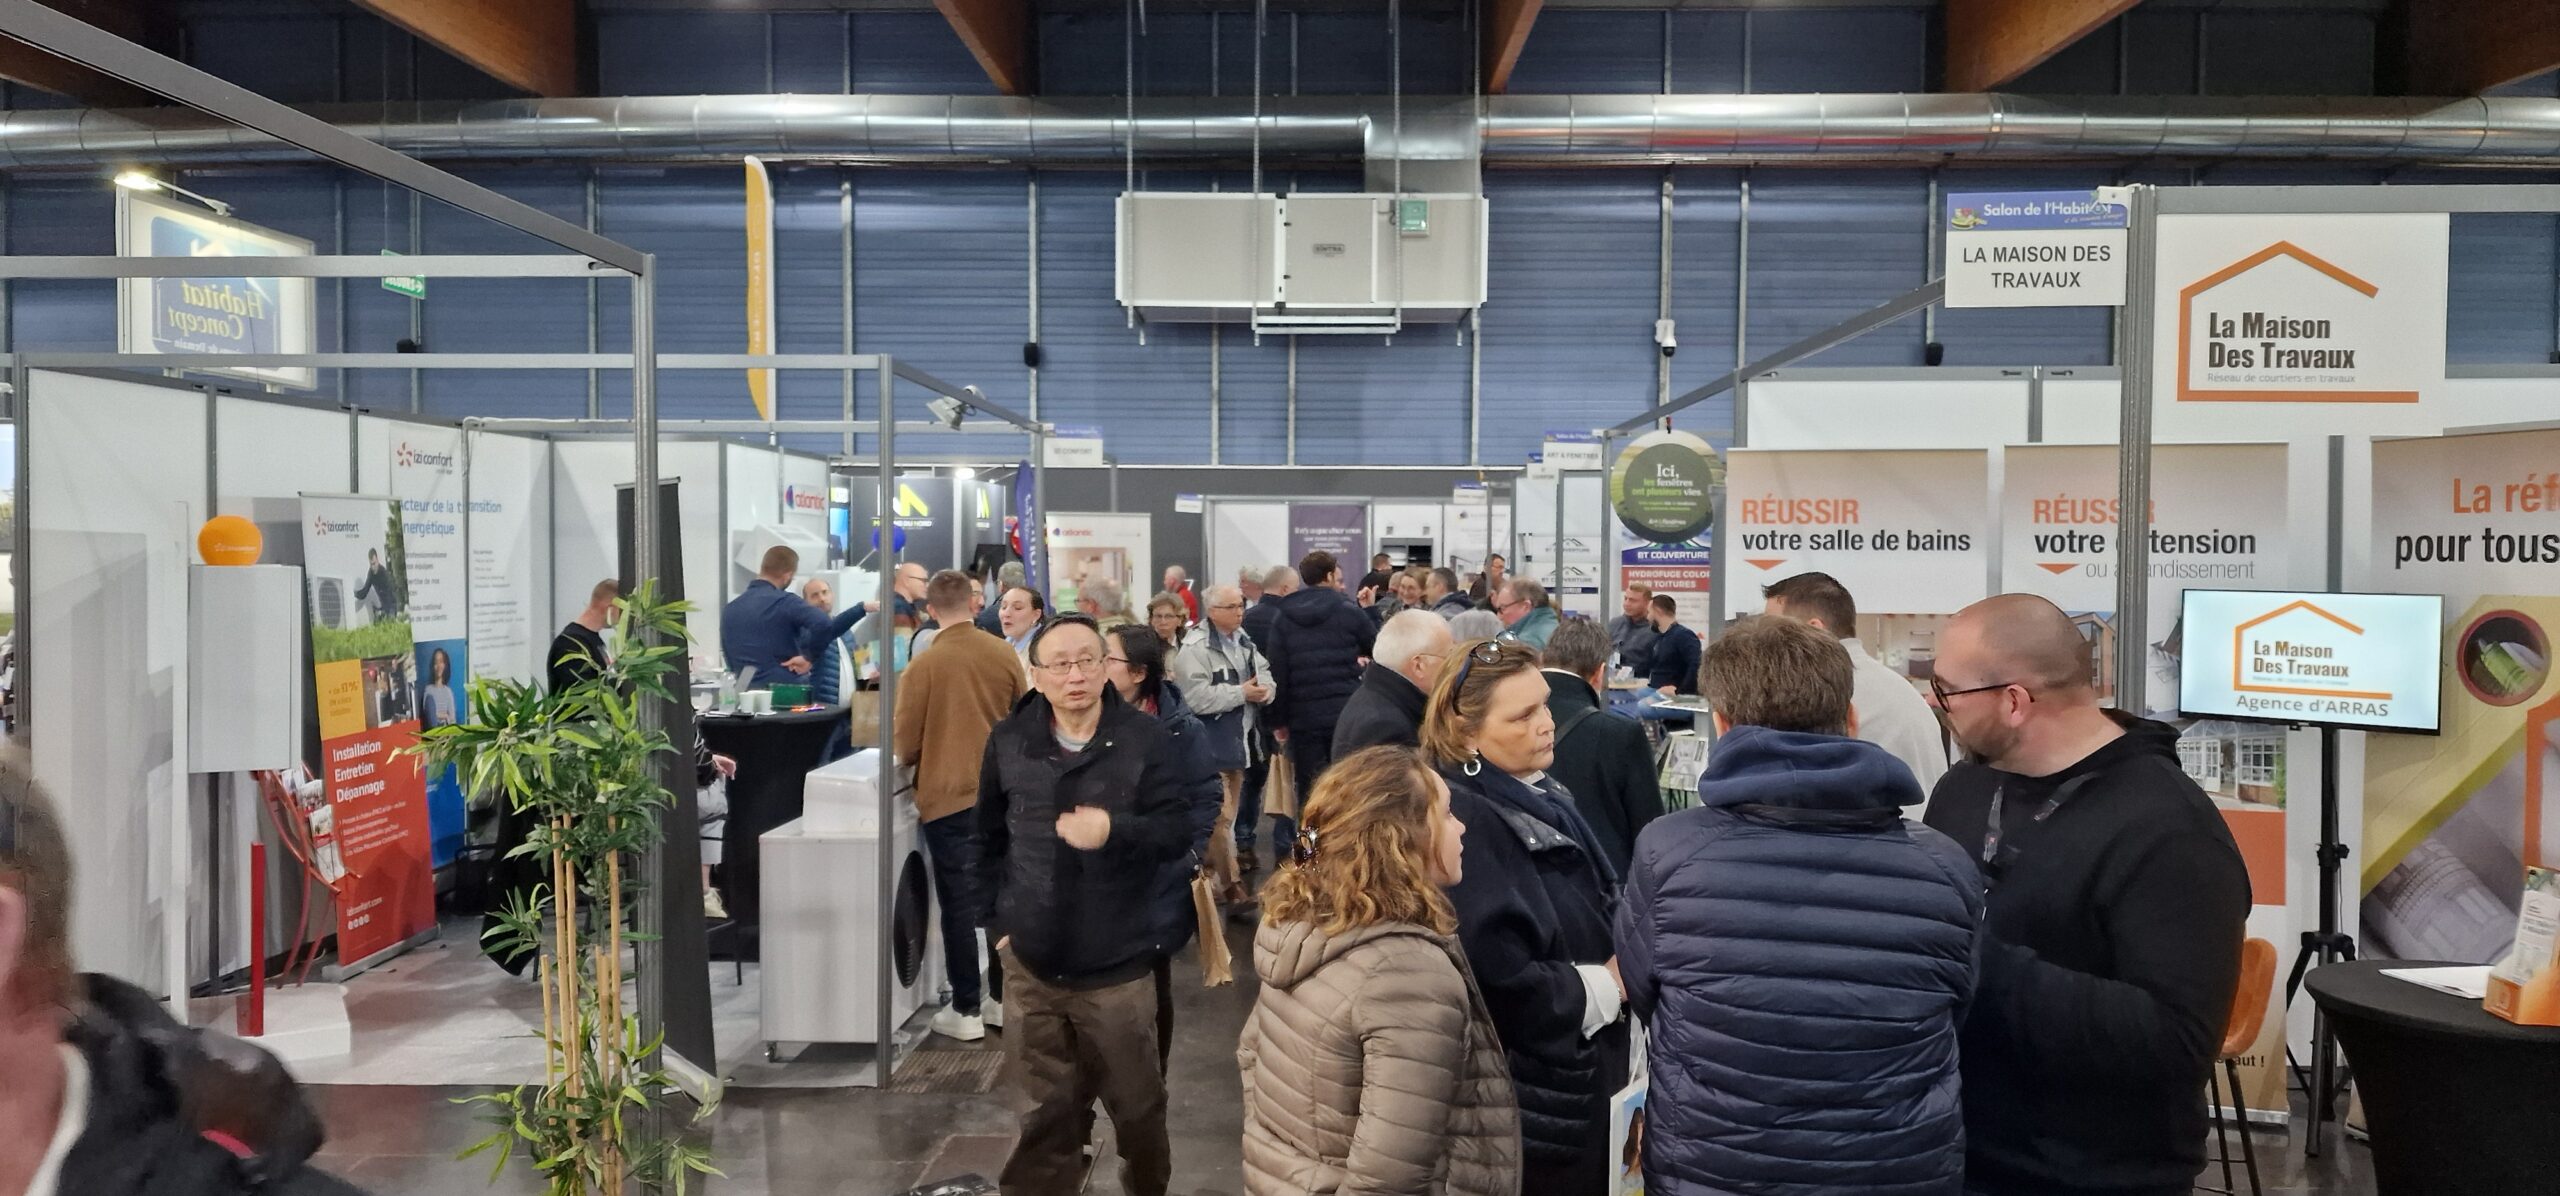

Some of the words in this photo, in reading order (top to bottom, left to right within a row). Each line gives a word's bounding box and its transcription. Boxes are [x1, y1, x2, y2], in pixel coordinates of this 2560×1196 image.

[1983, 202, 2021, 217] Salon
[2024, 201, 2041, 216] de
[1963, 247, 1987, 263] LA
[1993, 246, 2067, 263] MAISON
[2073, 245, 2111, 262] DES
[1991, 271, 2082, 289] TRAVAUX
[2209, 311, 2236, 339] La
[2242, 311, 2331, 339] Maison
[2208, 342, 2255, 369] Des
[2260, 342, 2356, 369] Travaux
[2207, 372, 2241, 383] Réseau
[2244, 372, 2256, 383] de
[2259, 372, 2302, 383] courtiers
[2305, 374, 2317, 383] en
[2320, 374, 2356, 383] travaux
[423, 451, 453, 467] confort
[1657, 463, 1680, 479] Ici,
[1656, 477, 1694, 487] fenêtres
[795, 491, 825, 511] atlantic
[1631, 488, 1645, 496] ont
[1646, 487, 1682, 498] plusieurs
[2453, 478, 2492, 514] La
[432, 499, 444, 513] de
[446, 499, 453, 513] la
[1741, 493, 1860, 525] RÉUSSIR
[403, 521, 455, 538] nergétique
[1062, 528, 1093, 537] atlantic
[1742, 530, 1802, 551] votre
[1809, 529, 1864, 551] salle
[1871, 529, 1900, 551] de
[1907, 529, 1972, 551] bains
[2034, 530, 2105, 554] votre
[2115, 529, 2256, 554] tension
[2395, 535, 2472, 570] pour
[2482, 528, 2560, 564] tous
[1638, 551, 1649, 559] BT
[1650, 551, 1709, 559] COUVERTURE
[1628, 569, 1681, 579] HYDROFUGE
[2086, 562, 2107, 579] ou
[1654, 580, 1697, 588] TOITURES
[2253, 640, 2271, 656] La
[2275, 641, 2333, 659] Maison
[2253, 657, 2283, 674] Des
[2287, 659, 2349, 678] Travaux
[2236, 694, 2303, 712] Agence
[2309, 699, 2389, 717] d'ARRAS
[333, 740, 382, 762] Installation
[334, 761, 375, 782] Entretien
[336, 779, 385, 804] Dépannage
